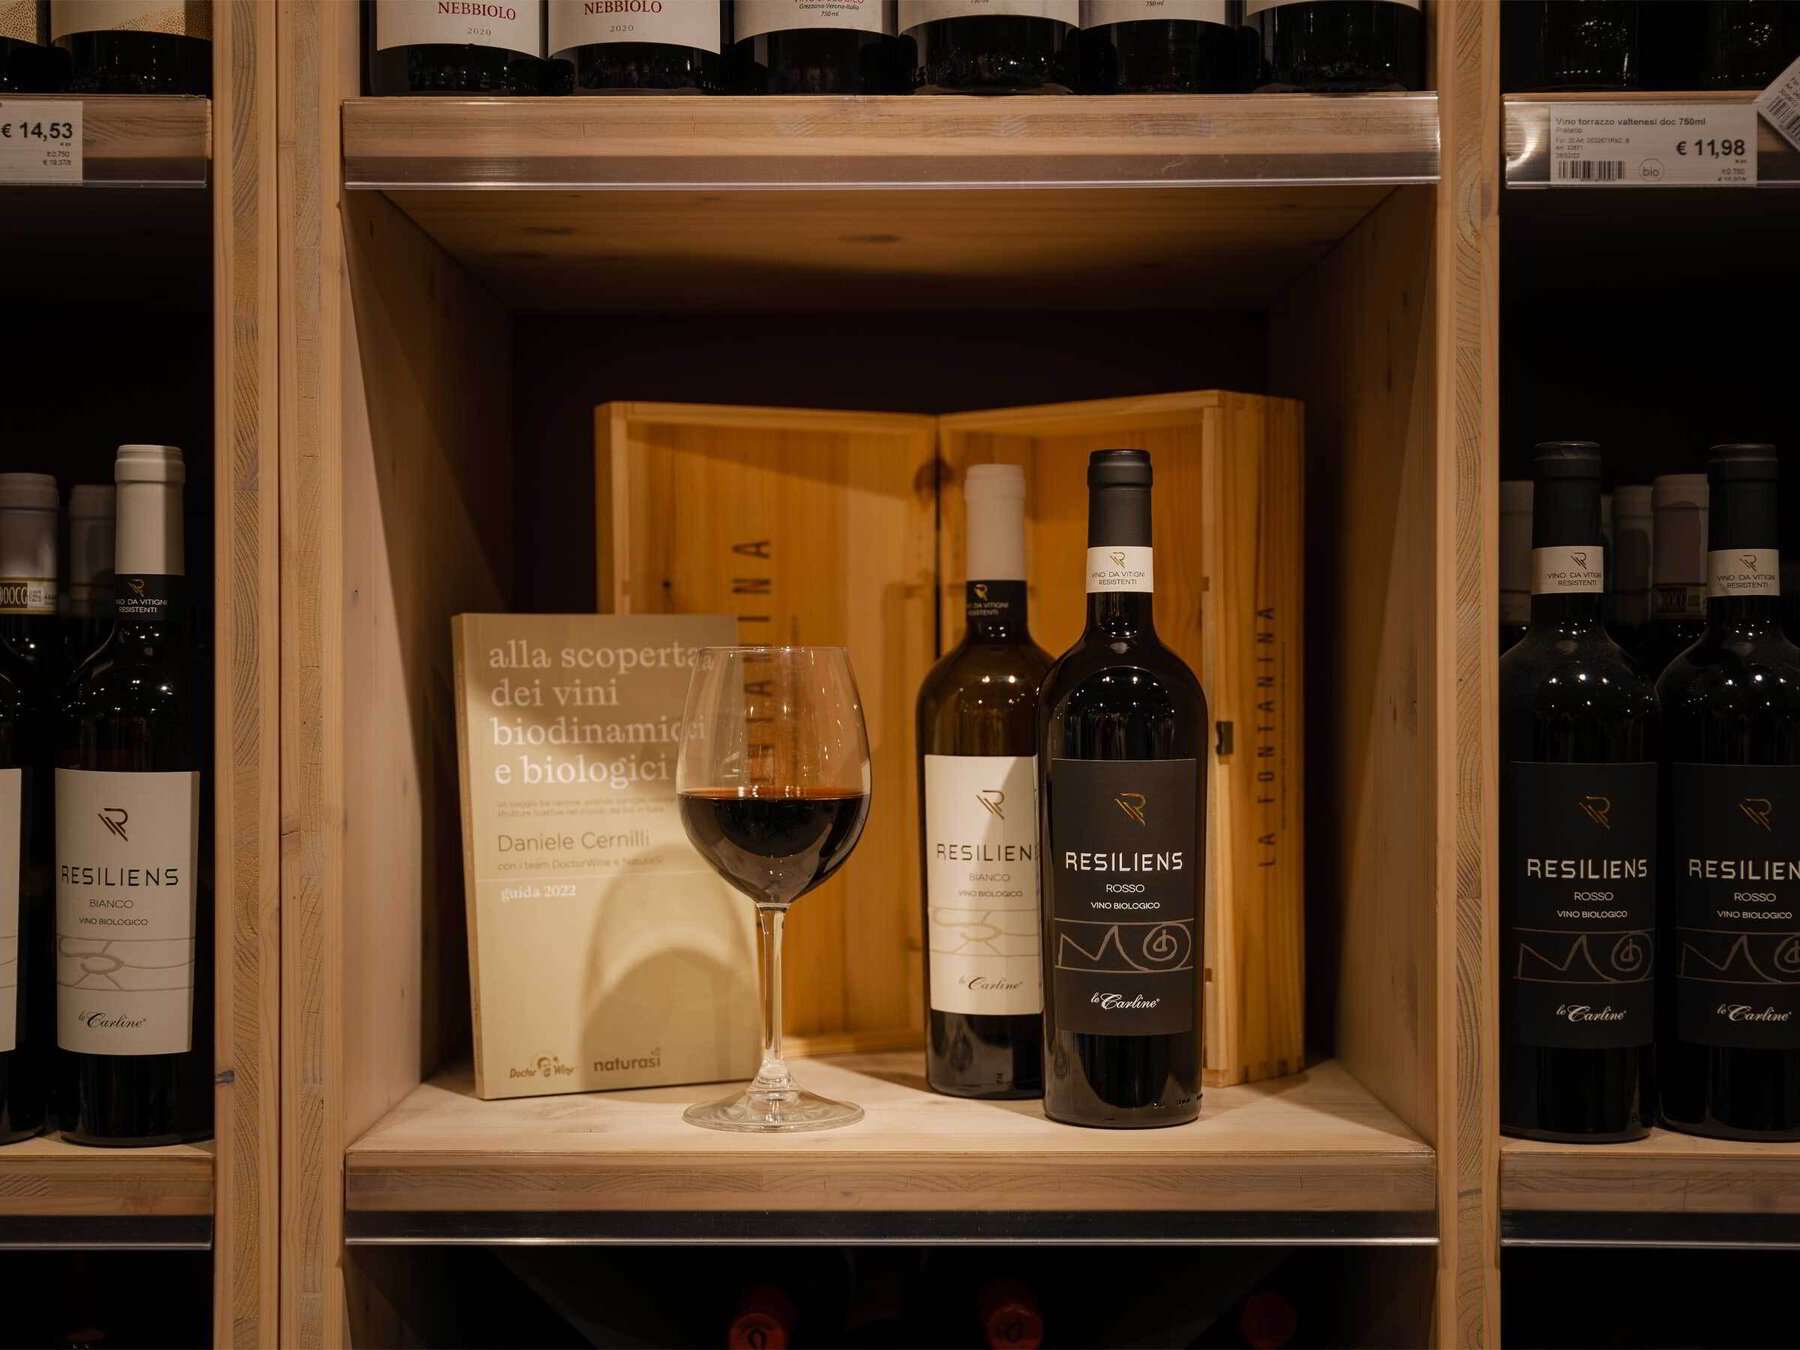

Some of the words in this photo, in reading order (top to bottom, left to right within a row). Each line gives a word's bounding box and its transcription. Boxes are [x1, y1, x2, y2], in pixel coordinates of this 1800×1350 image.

[438, 2, 516, 20] NEBBIOLO
[584, 0, 663, 15] NEBBIOLO
[467, 27, 492, 35] 2020
[609, 24, 634, 32] 2020
[1556, 117, 1576, 126] Vino
[1578, 117, 1615, 126] torrazzo
[1617, 117, 1658, 126] valtenesi
[1659, 117, 1676, 126] doc
[1679, 117, 1706, 126] 750ml
[1, 123, 12, 138] €
[19, 121, 73, 142] 14,53
[1676, 141, 1687, 156] €
[1695, 139, 1746, 159] 11,98
[1643, 166, 1660, 177] bio
[1098, 578, 1137, 586] RESISTENTI
[1557, 579, 1597, 587] RESISTENTI
[1716, 574, 1736, 582] VINO
[1738, 573, 1751, 581] DA
[489, 639, 552, 669] alla
[560, 641, 708, 675] scoperta
[490, 678, 544, 707] dei
[552, 678, 621, 707] vini
[1257, 606, 1276, 804] FONTANINA
[489, 715, 706, 746] biodinamici
[494, 762, 512, 785] e
[519, 753, 670, 790] biologici
[498, 832, 575, 853] Daniele
[580, 829, 650, 850] Cernilli
[936, 843, 1037, 861] RESILIEN
[1258, 832, 1276, 867] LA
[498, 862, 516, 871] con
[524, 860, 549, 870] team
[552, 857, 611, 869] DoctorWine
[1065, 851, 1184, 872] RESILIENS
[1526, 858, 1648, 880] RESILIENS
[1688, 858, 1800, 881] RESILIEN
[61, 864, 179, 887] RESILIENS
[968, 873, 1011, 882] BIANCO
[500, 885, 541, 904] guida
[543, 883, 577, 897] 2022
[958, 890, 977, 898] VINO
[978, 890, 1024, 898] BIOLOGICO
[1106, 883, 1145, 894] ROSSO
[1573, 891, 1614, 902] ROSSO
[89, 898, 134, 910] BIANCO
[1733, 892, 1777, 903] ROSSO
[1090, 901, 1112, 910] VINO
[1113, 901, 1161, 911] BIOLOGICO
[1556, 909, 1581, 919] VINO
[1581, 909, 1628, 919] BIOLOGICO
[79, 917, 98, 925] VINO
[98, 918, 149, 927] BIOLOGICO
[1716, 910, 1741, 919] VINO
[1742, 911, 1793, 920] BIOLOGICO
[967, 976, 1021, 992] Carline
[1090, 991, 1100, 1004] le
[1100, 992, 1158, 1011] Carline
[86, 1011, 145, 1029] Carline
[1567, 1004, 1626, 1023] Carline
[1727, 1004, 1790, 1023] Carline
[509, 1067, 537, 1079] Doctor
